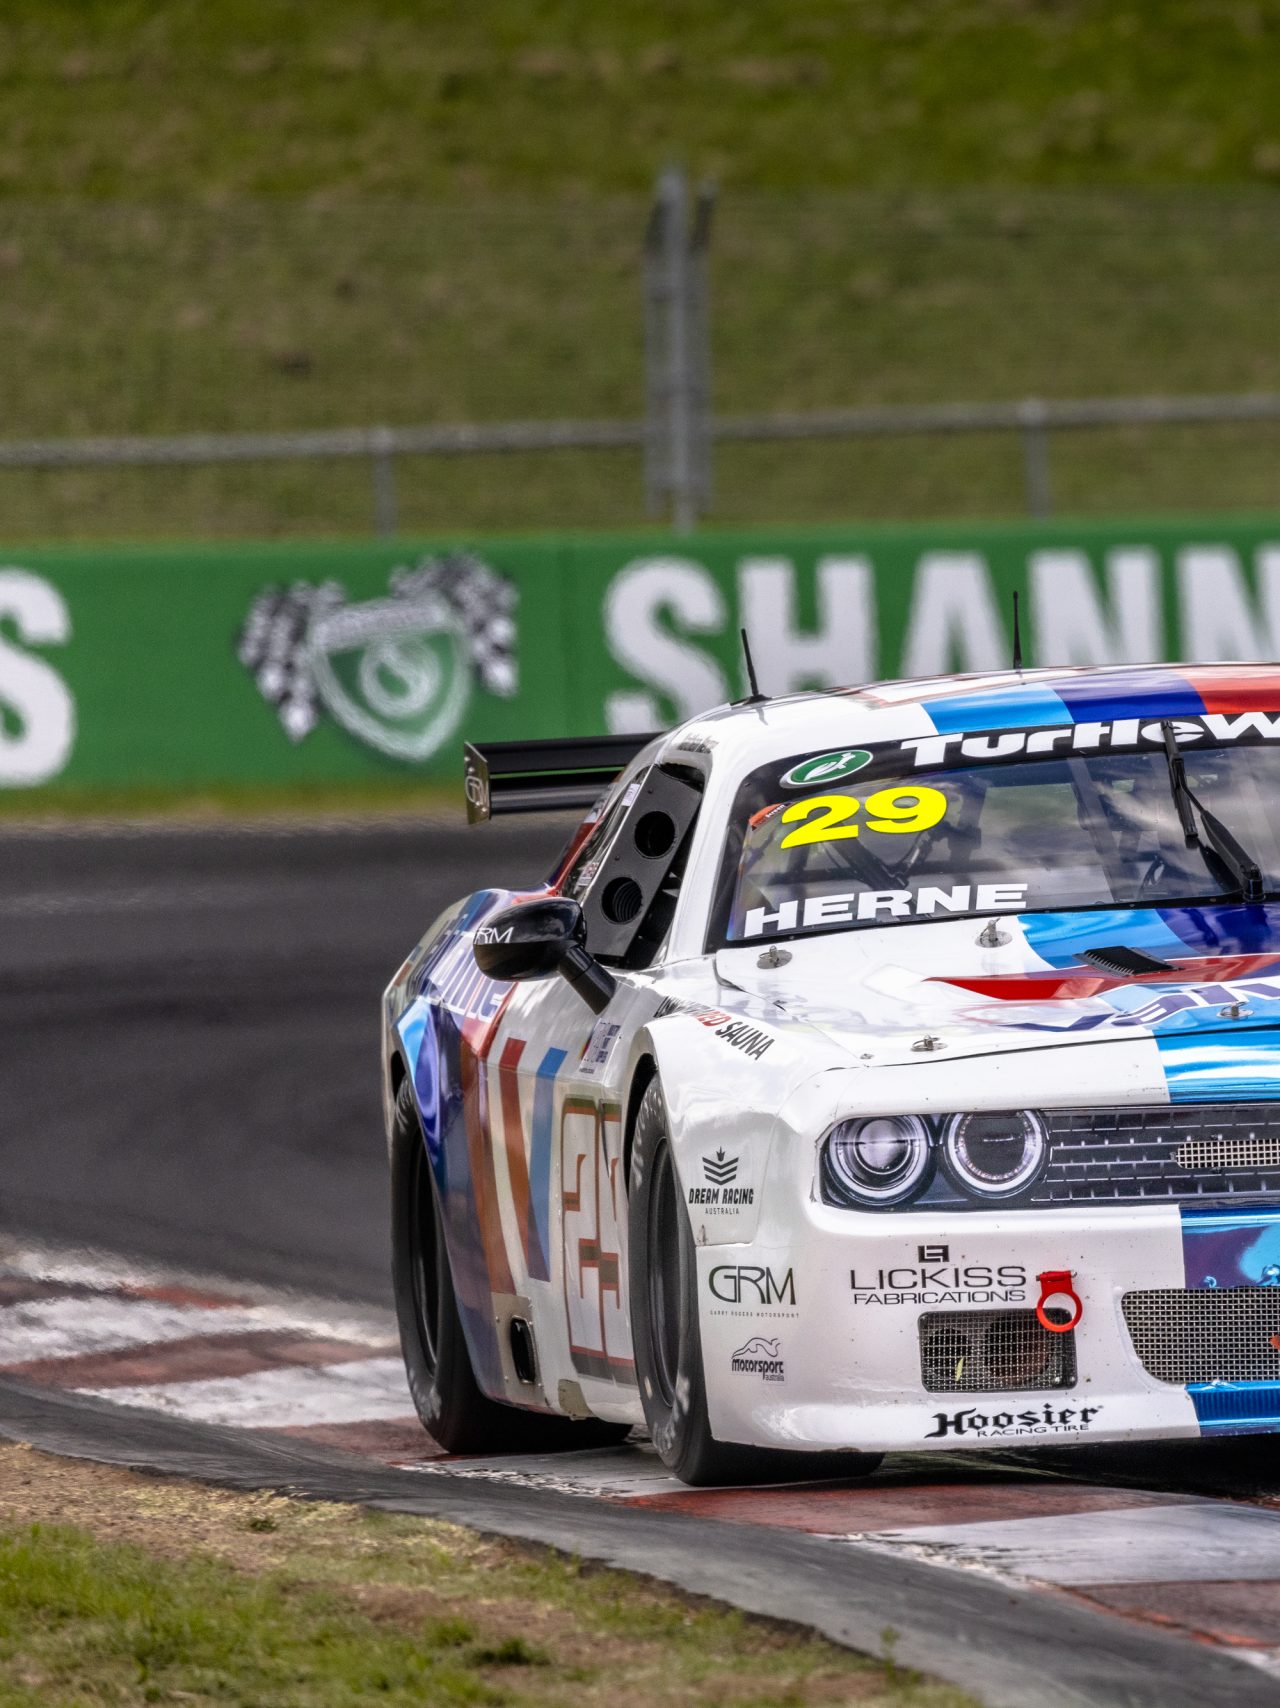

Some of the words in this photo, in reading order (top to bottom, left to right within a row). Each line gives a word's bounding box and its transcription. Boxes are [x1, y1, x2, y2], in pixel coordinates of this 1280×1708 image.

[780, 786, 948, 849] 29
[743, 883, 1028, 938] HERNE
[715, 1020, 775, 1061] SAUNA
[688, 1188, 719, 1204] DREAM
[722, 1188, 754, 1205] RACING
[705, 1207, 740, 1215] AUSTRALIA
[708, 1265, 797, 1306] GRM
[850, 1265, 1027, 1290] LICKISS
[853, 1290, 1026, 1305] FABRICATIONS
[924, 1402, 1102, 1439] Hoosier
[977, 1425, 1047, 1437] RACING
[1051, 1423, 1089, 1432] TIRE
